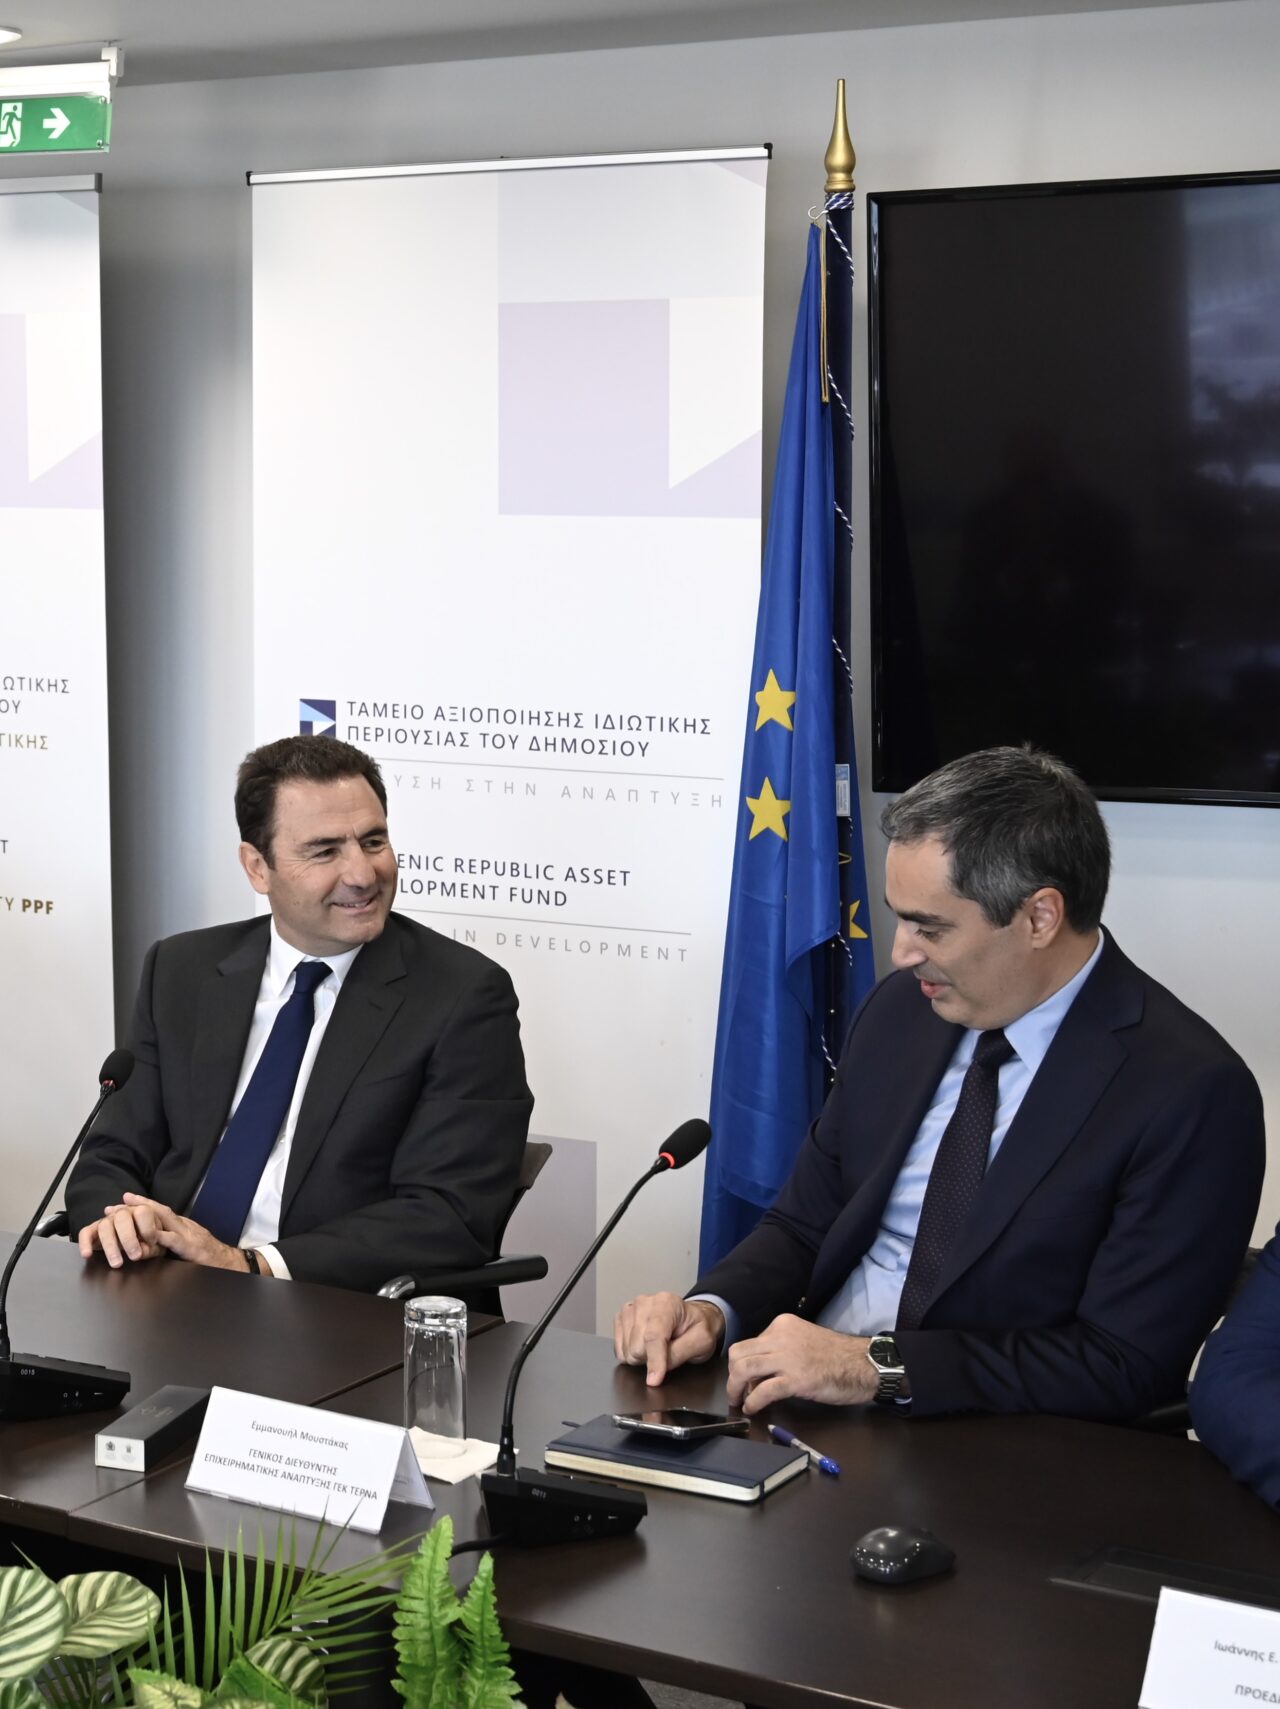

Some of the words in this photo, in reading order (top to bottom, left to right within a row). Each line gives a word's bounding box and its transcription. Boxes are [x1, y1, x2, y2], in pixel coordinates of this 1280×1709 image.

[347, 701, 424, 720] ΤΑΜΕΙΟ
[434, 706, 584, 729] ΑΞΙΟΠΟΙΗΣΗΣ
[595, 713, 711, 735] ΙΔΙΩΤΙΚΗΣ
[347, 726, 470, 748] ΠΕΡΙΟΥΣΙΑΣ
[479, 732, 519, 750] ΤΟΥ
[529, 736, 650, 758] ΔΗΜΟΣΙΟΥ
[466, 779, 536, 796] ΣΤΗΝ
[561, 785, 722, 808] ΑΝΑΠΤΥΞΗ
[397, 854, 444, 872] ENIC
[454, 857, 555, 881] REPUBLIC
[564, 866, 631, 887] ASSET
[22, 899, 54, 915] PPF
[400, 879, 499, 901] LOPMENT
[509, 887, 567, 906] FUND
[452, 928, 476, 943] IN
[497, 932, 688, 962] DEVELOPMENT
[251, 1421, 298, 1439] Εμμανουήλ
[300, 1431, 349, 1451] Μουστάκας
[204, 1453, 279, 1478] ΕΠΙΧΕΙΡΗΜΑΤΙΚΗΣ
[281, 1471, 331, 1489] ΑΝΑΠΤΥΞΗΣ
[333, 1483, 348, 1494] ΓΕΚ
[350, 1486, 377, 1500] ΤΕΡΝΑ
[249, 1449, 283, 1464] ΓΕΝΙΚΟΣ
[285, 1456, 338, 1476] ΔΙΕΥΘΥΝΤΗΣ
[1214, 1640, 1264, 1662] Ιωάννης
